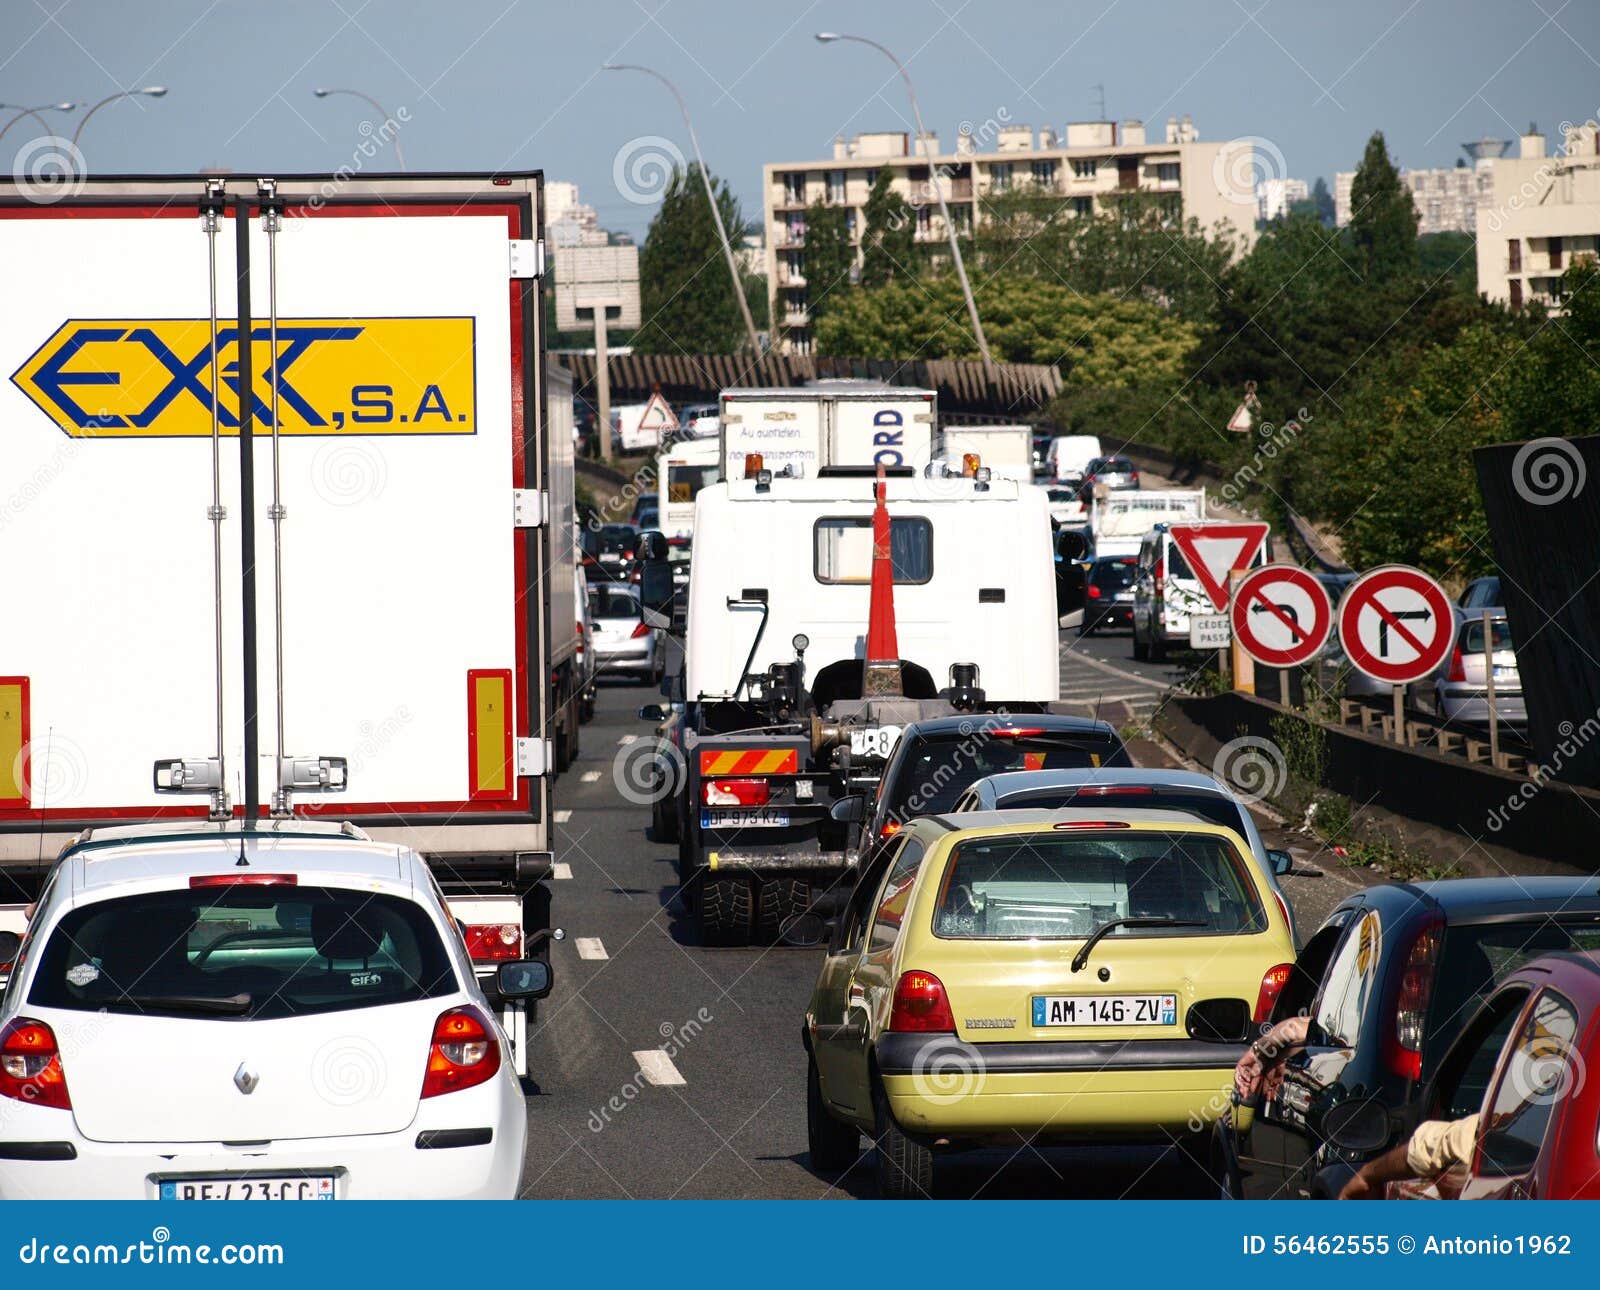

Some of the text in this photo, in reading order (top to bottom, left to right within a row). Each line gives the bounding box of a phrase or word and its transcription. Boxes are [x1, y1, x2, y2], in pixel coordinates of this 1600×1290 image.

[1200, 634, 1232, 643] PASSA
[351, 976, 370, 985] elf
[1050, 999, 1160, 1023] AM-146-ZV
